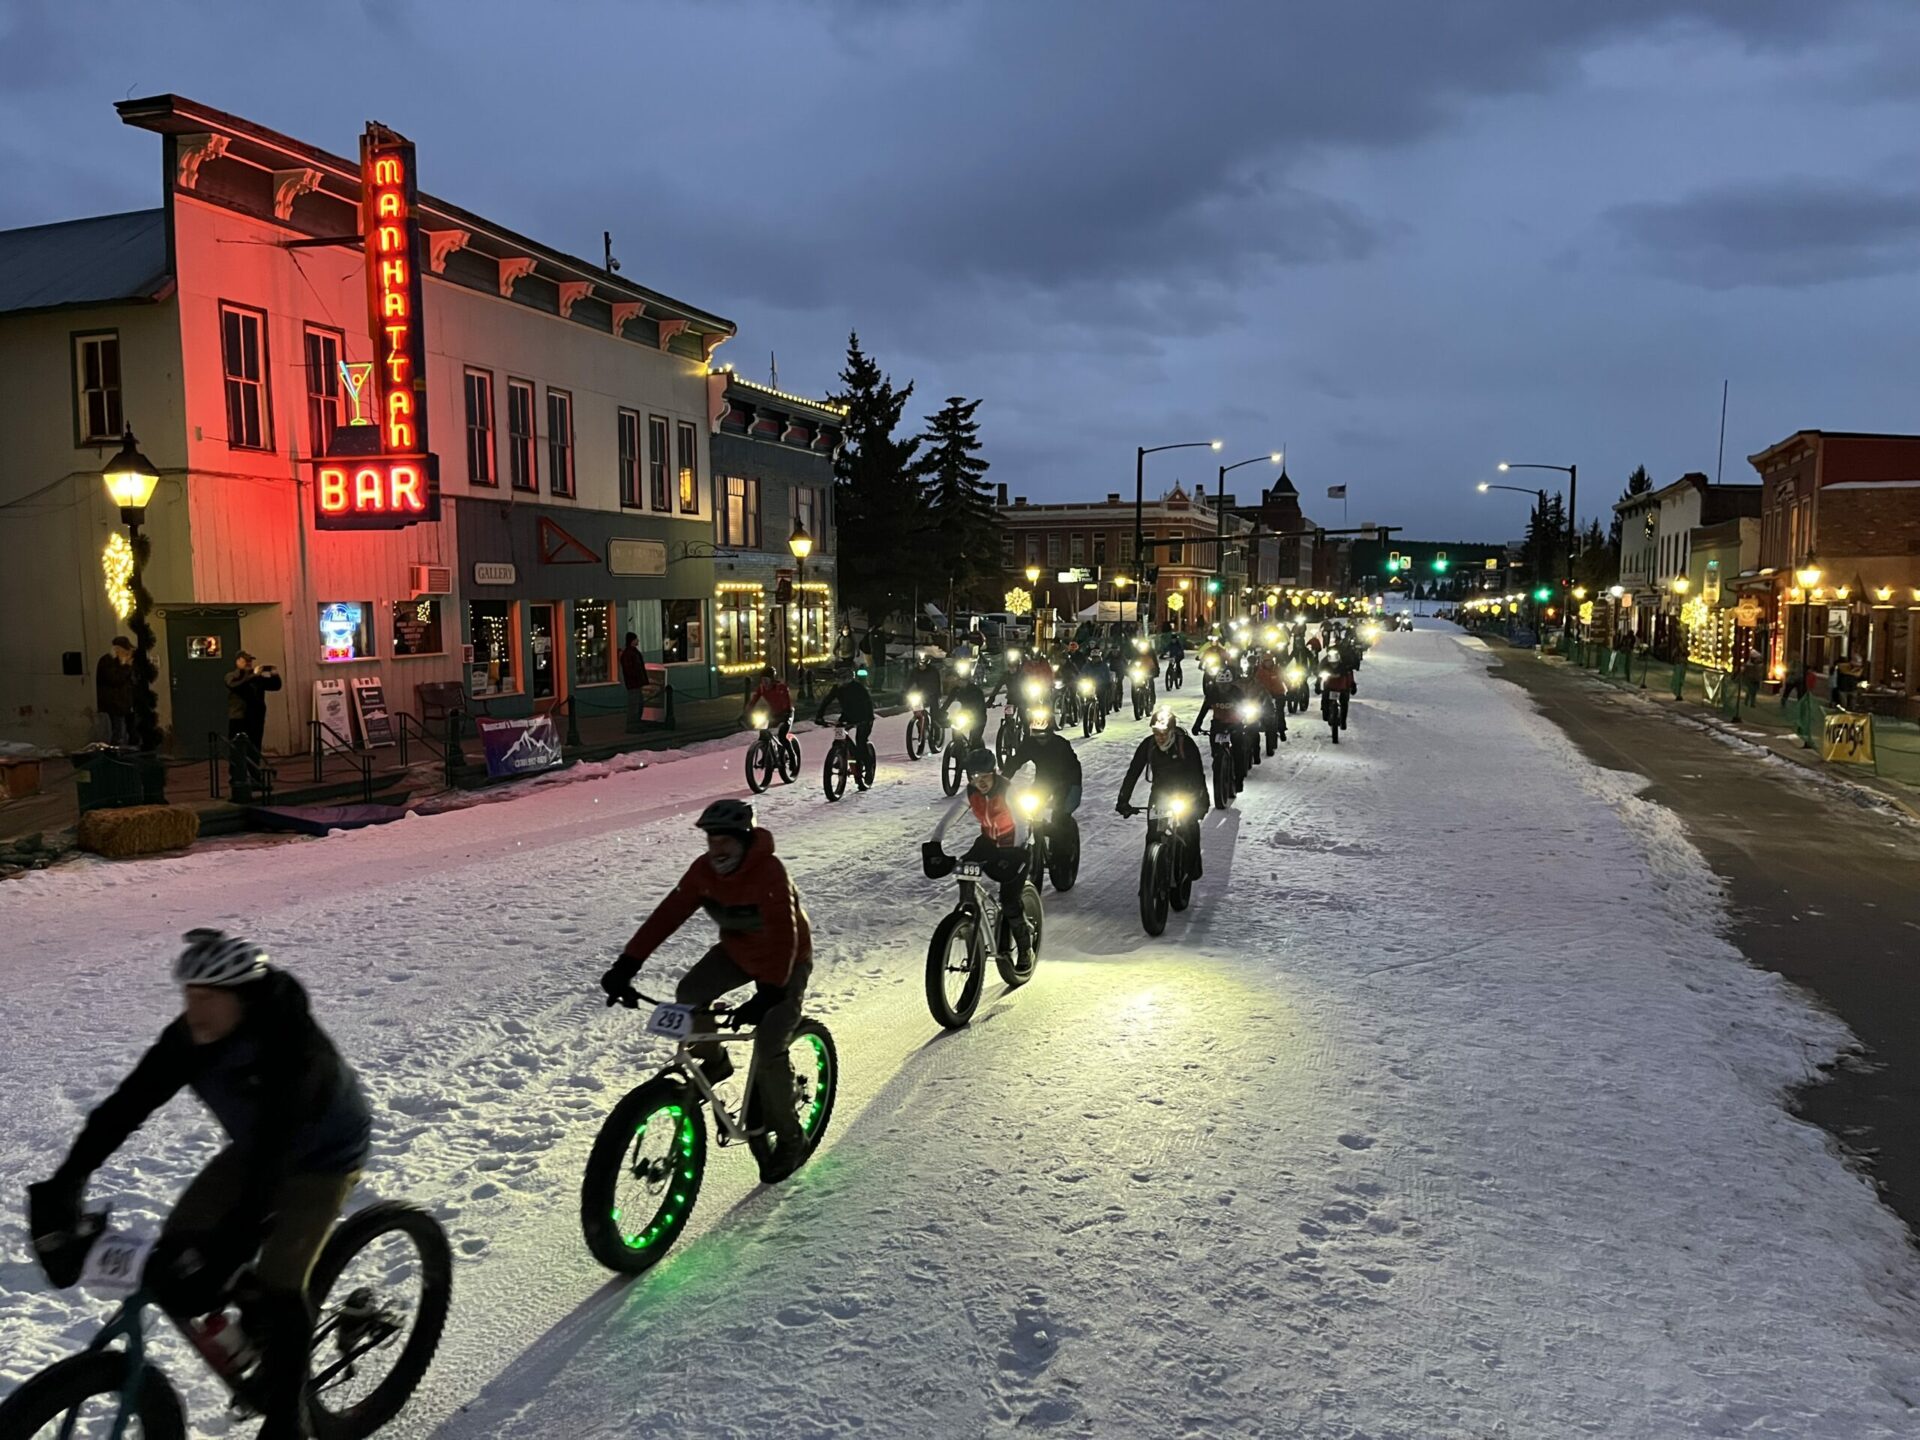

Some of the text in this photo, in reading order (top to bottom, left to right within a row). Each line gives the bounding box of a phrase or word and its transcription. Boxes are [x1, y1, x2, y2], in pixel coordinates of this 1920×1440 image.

[319, 465, 425, 512] BAR
[477, 566, 513, 580] GALLERY
[656, 1010, 685, 1030] 293
